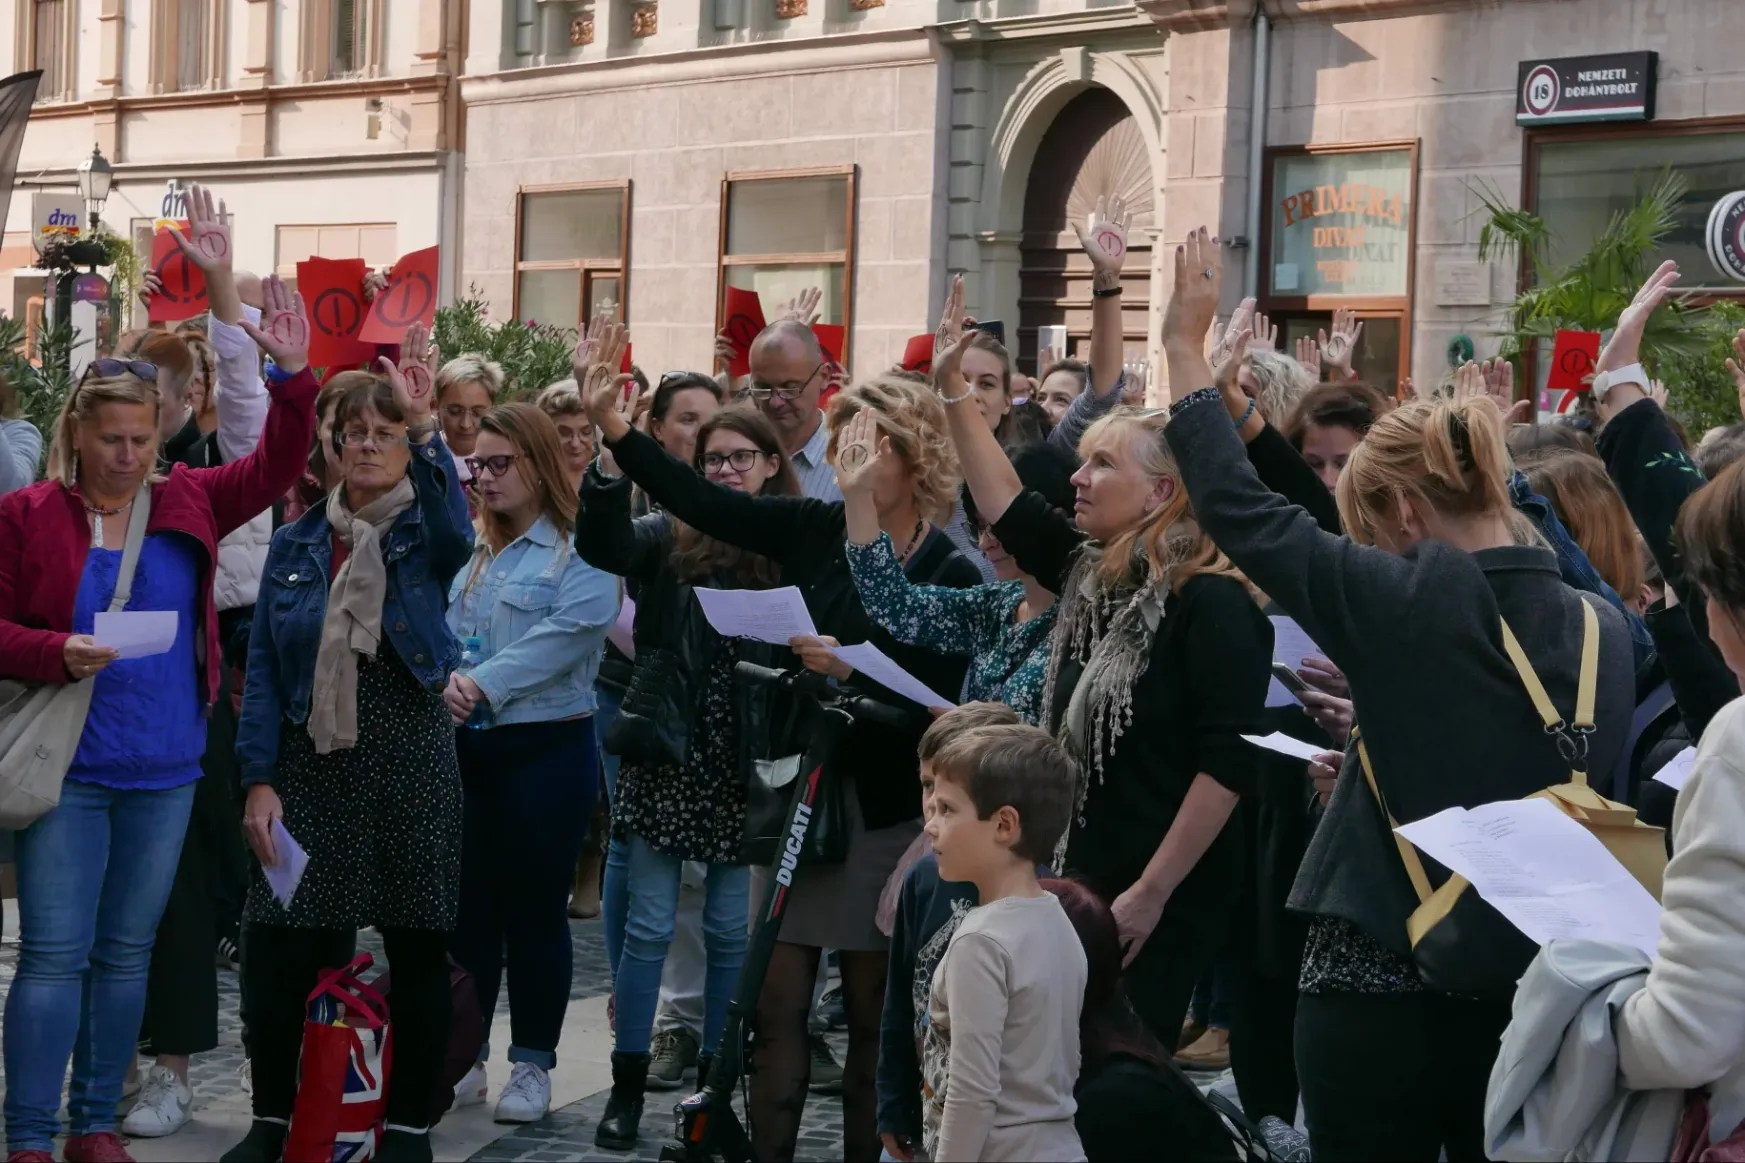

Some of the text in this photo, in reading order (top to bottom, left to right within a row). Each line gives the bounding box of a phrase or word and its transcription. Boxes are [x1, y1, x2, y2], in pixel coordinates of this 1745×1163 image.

[1578, 68, 1627, 82] NEMZETI
[1534, 84, 1550, 100] 18
[1565, 83, 1639, 98] DOHÁNYBOLT
[1281, 183, 1402, 228] PRIMERA
[48, 208, 77, 226] dm
[1313, 225, 1368, 248] DIVAT
[776, 802, 813, 888] DUCATI
